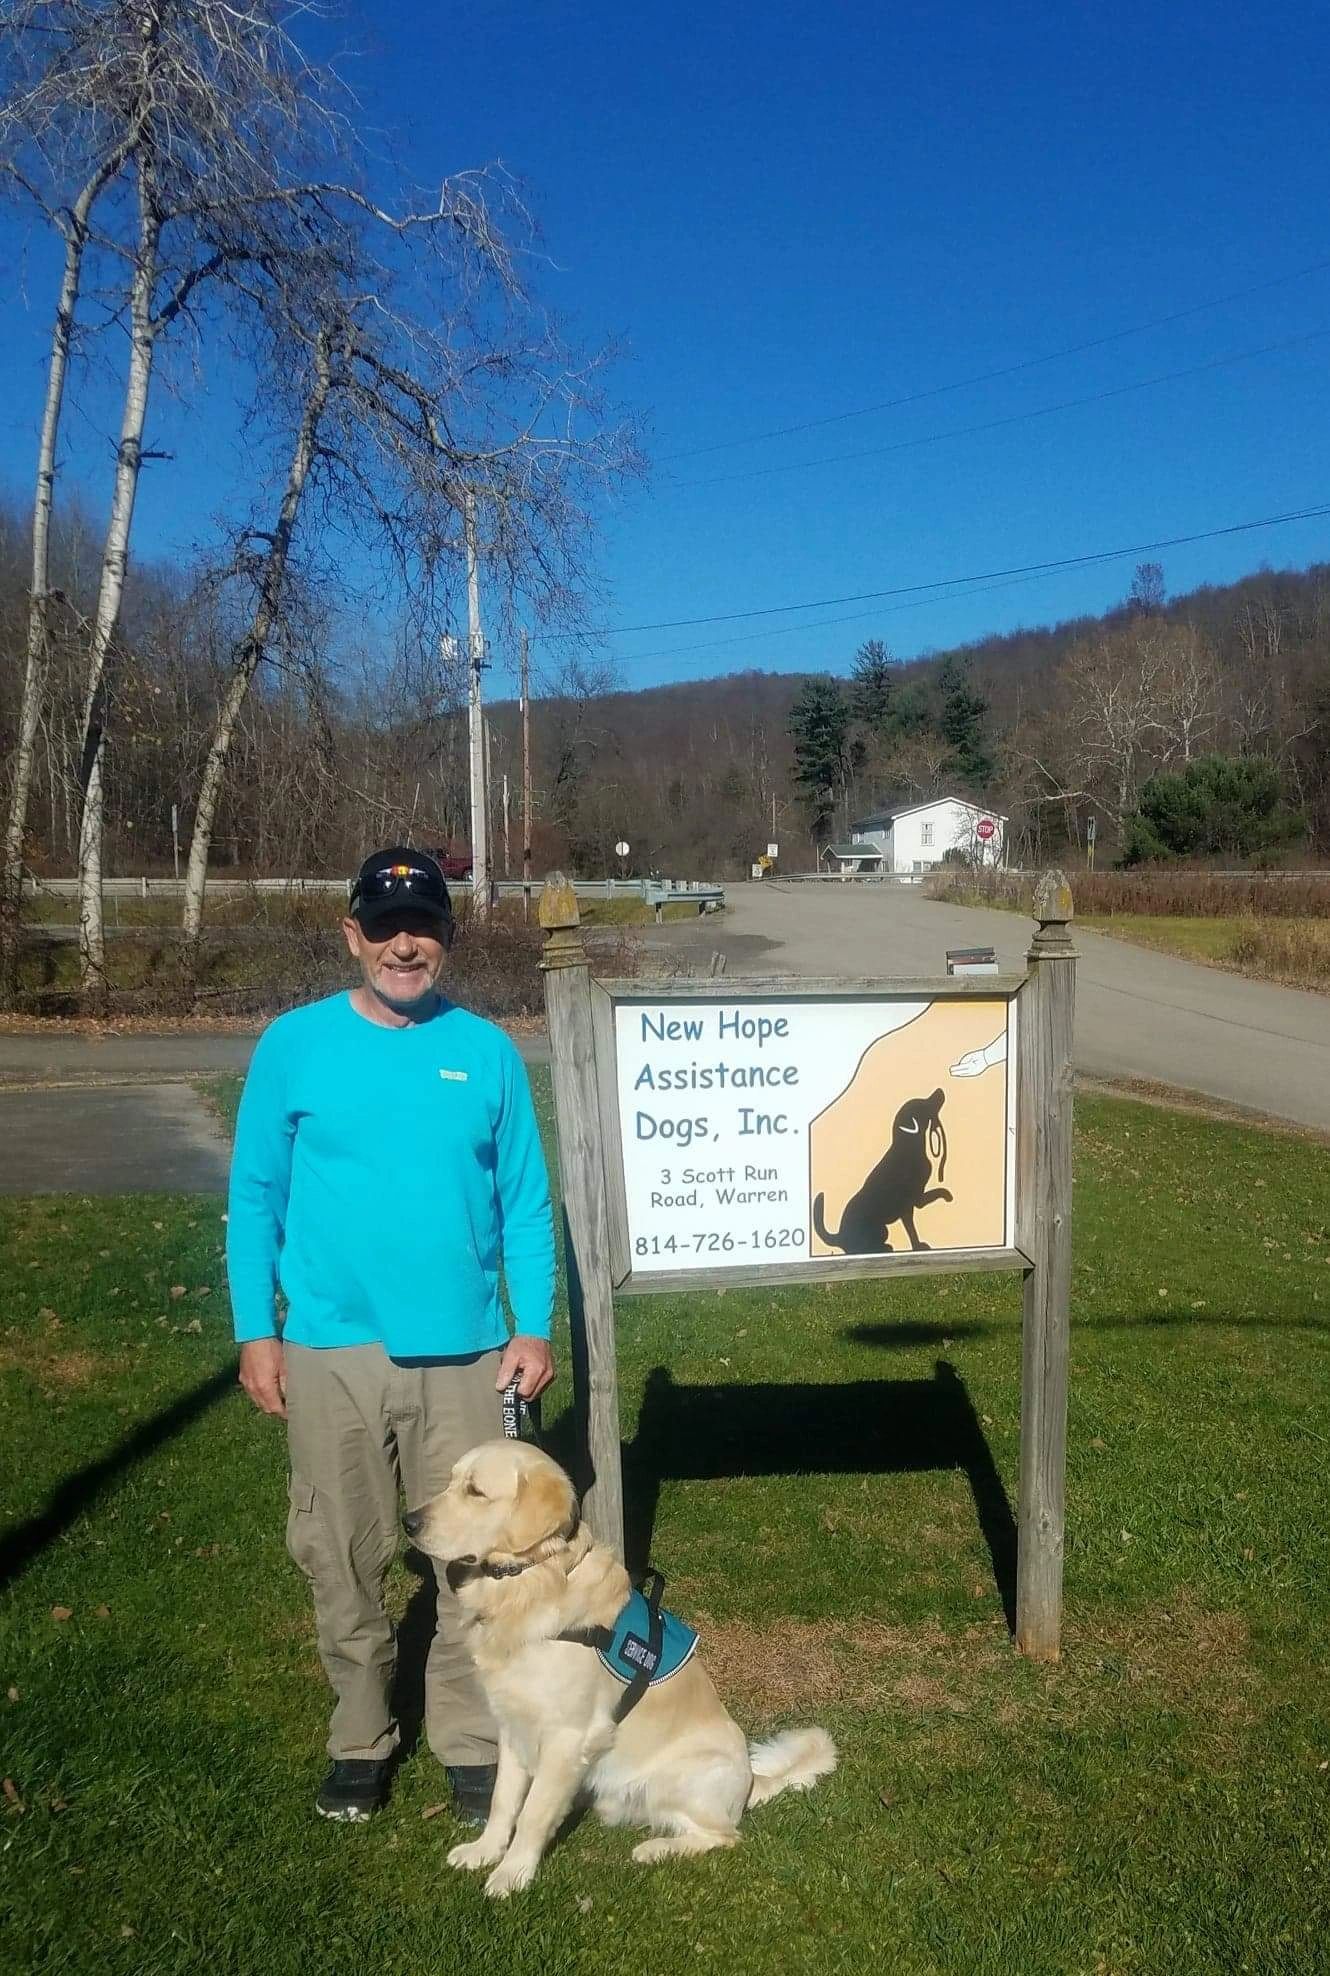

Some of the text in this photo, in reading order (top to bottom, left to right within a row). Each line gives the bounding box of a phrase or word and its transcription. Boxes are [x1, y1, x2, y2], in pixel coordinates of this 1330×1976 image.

[977, 825, 994, 833] STOP
[641, 1010, 790, 1048] New Hope
[634, 1061, 800, 1091] Assistance
[636, 1108, 799, 1147] Dogs, Inc.
[660, 1165, 778, 1185] 3 Scott Run
[651, 1188, 788, 1208] Road, Warren
[635, 1228, 805, 1256] 814-726-1620
[503, 1383, 517, 1405] THE
